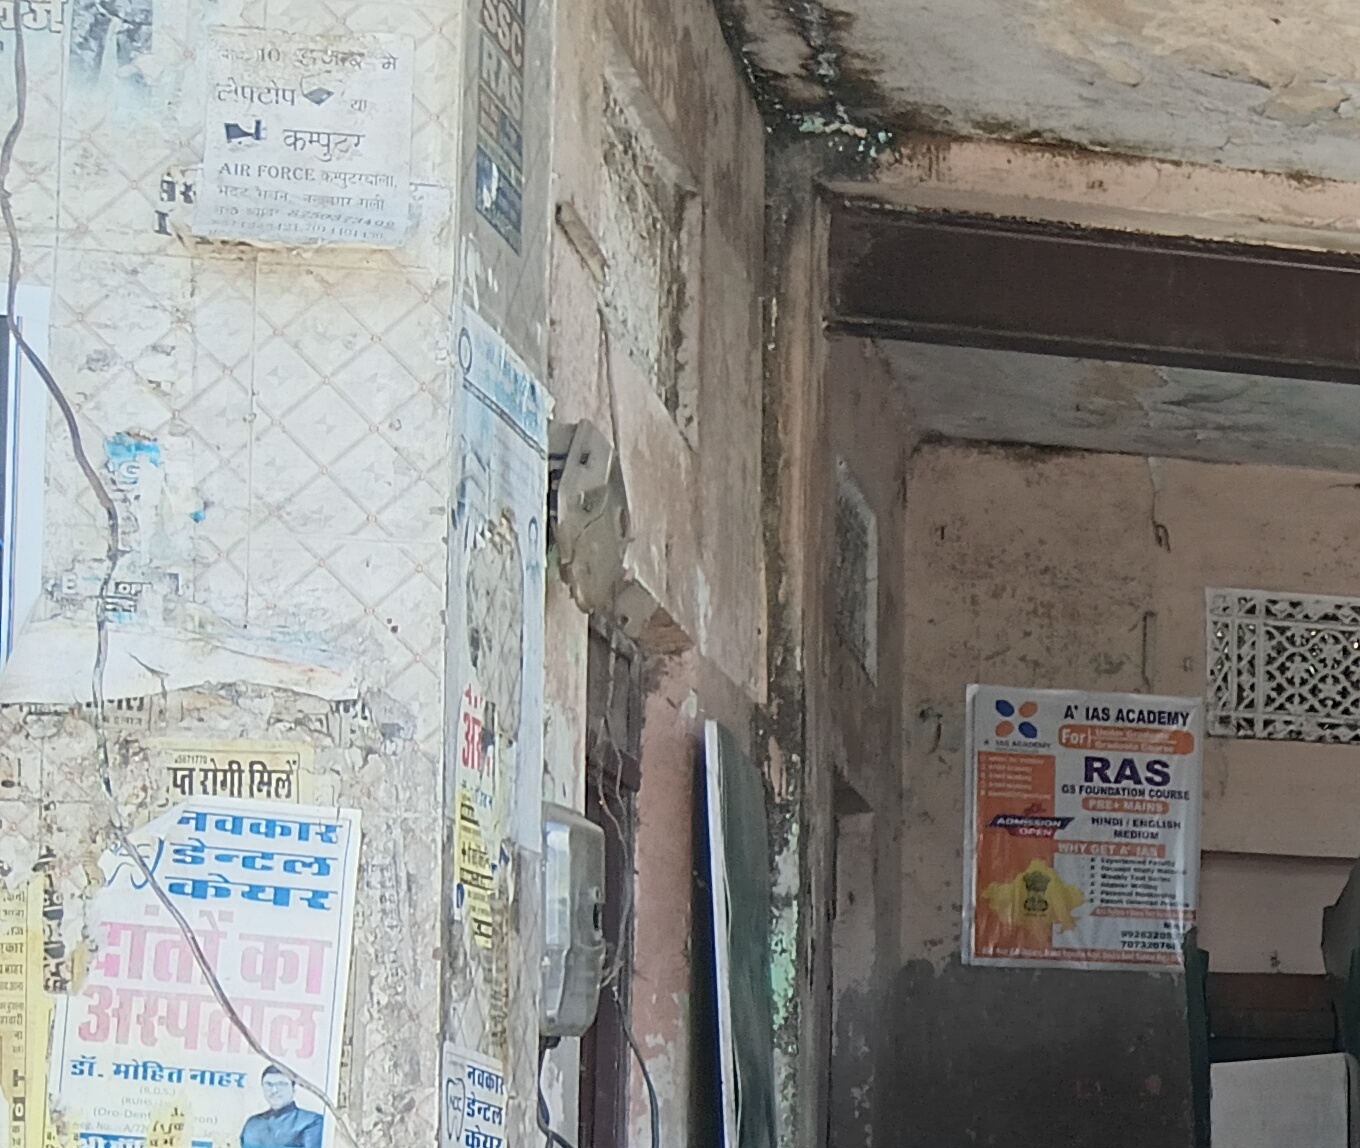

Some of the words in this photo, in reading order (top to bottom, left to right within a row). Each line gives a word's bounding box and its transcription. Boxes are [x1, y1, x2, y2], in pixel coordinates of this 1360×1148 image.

[218, 162, 250, 178] AIR
[257, 165, 315, 182] FORCE
[1085, 705, 1111, 722] IAS
[1115, 707, 1191, 728] ACADEMY
[1061, 727, 1087, 745] For
[200, 758, 245, 798] रोगी
[248, 759, 297, 800] मिलें
[1084, 755, 1172, 788] RAS
[1079, 784, 1147, 799] FOUNDATION
[1148, 787, 1191, 801] COURSE
[177, 810, 344, 845] नवकार
[996, 817, 1062, 828] ADMISSION
[1019, 827, 1053, 837] OPEN
[1091, 816, 1123, 827] HINDI
[1132, 818, 1182, 830] ENGLISH
[1113, 829, 1160, 841] MEDIUM
[170, 837, 339, 878] डेन्टल
[165, 872, 339, 912] केयर
[239, 933, 333, 995] का
[78, 984, 325, 1059] अस्पताल
[113, 1059, 186, 1085] मोहित
[190, 1068, 249, 1089] नाहर
[466, 1064, 504, 1097] नवकार
[464, 1094, 504, 1127] डेन्टल
